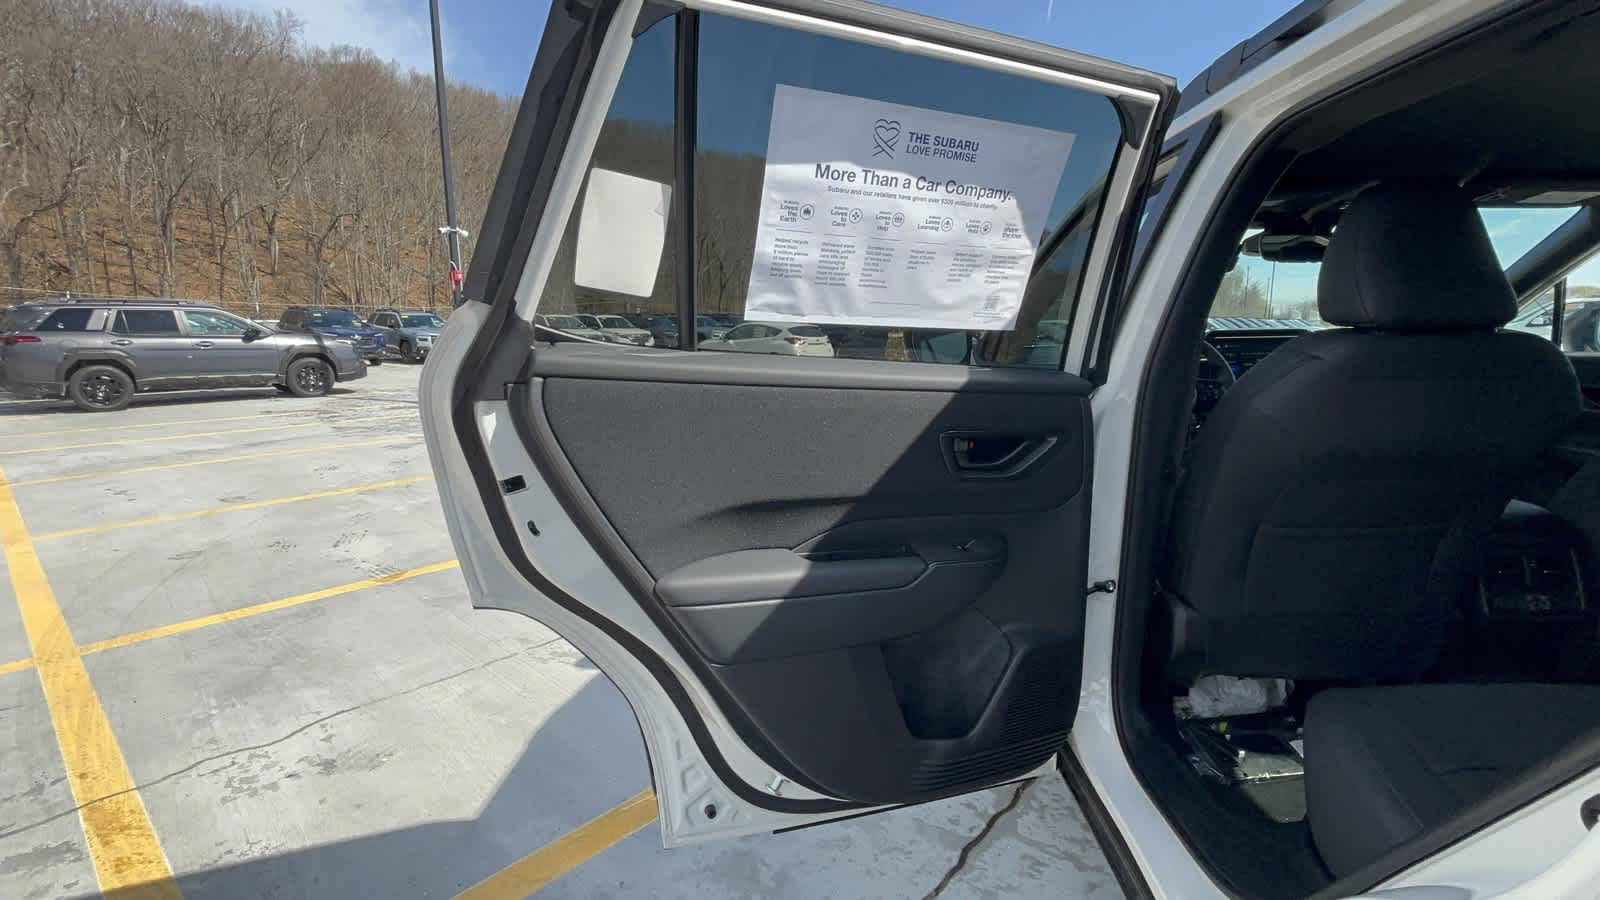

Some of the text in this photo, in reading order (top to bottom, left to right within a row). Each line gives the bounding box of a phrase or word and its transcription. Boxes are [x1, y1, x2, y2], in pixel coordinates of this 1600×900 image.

[908, 131, 980, 152] THE SUBARU
[906, 144, 977, 163] LOVE PROMISE
[814, 163, 1012, 203] More Than a Car Company.
[828, 185, 849, 194] Subaru
[850, 187, 862, 195] and
